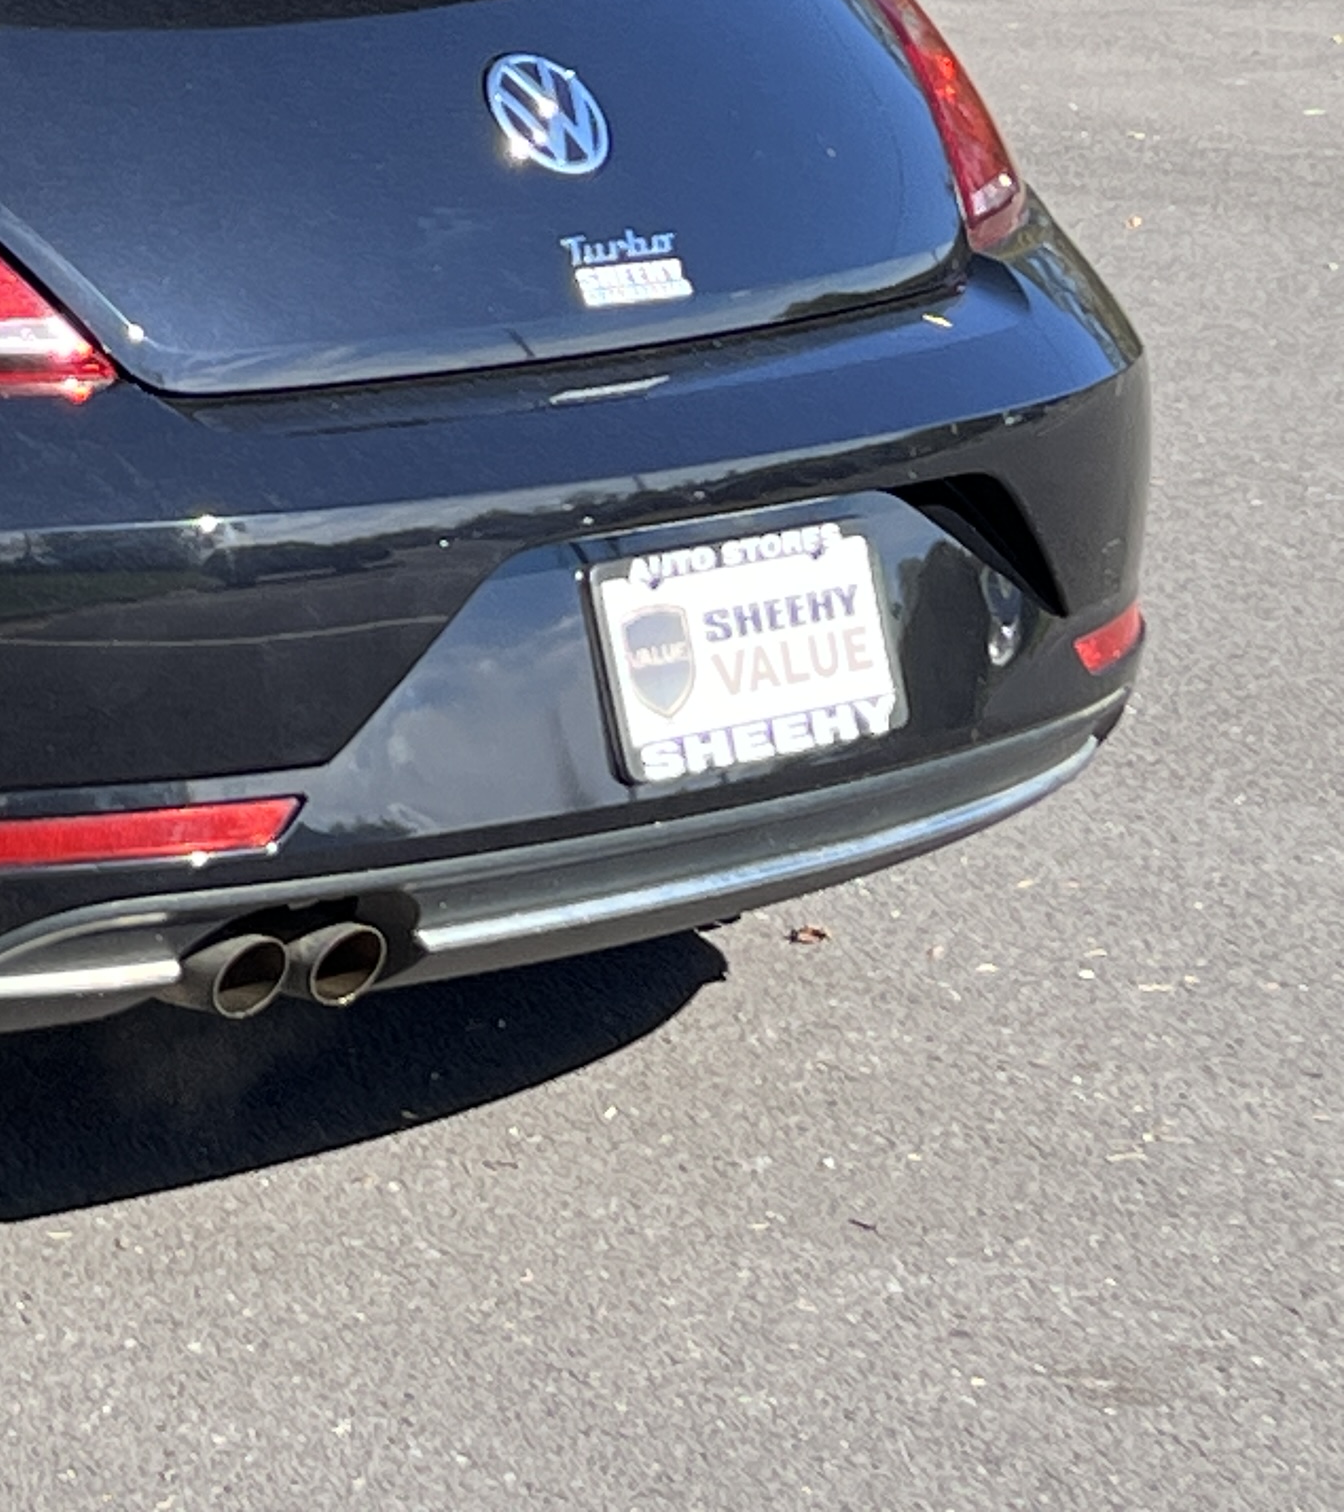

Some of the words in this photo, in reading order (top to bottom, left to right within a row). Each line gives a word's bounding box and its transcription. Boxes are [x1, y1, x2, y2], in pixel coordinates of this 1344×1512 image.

[559, 229, 676, 266] Turbo
[628, 545, 714, 585] AUTO
[720, 523, 843, 567] STORES
[702, 584, 858, 642] SHEEHY
[626, 641, 690, 669] VALUE
[710, 627, 874, 696] VALUE
[640, 693, 895, 781] SHEEHY
